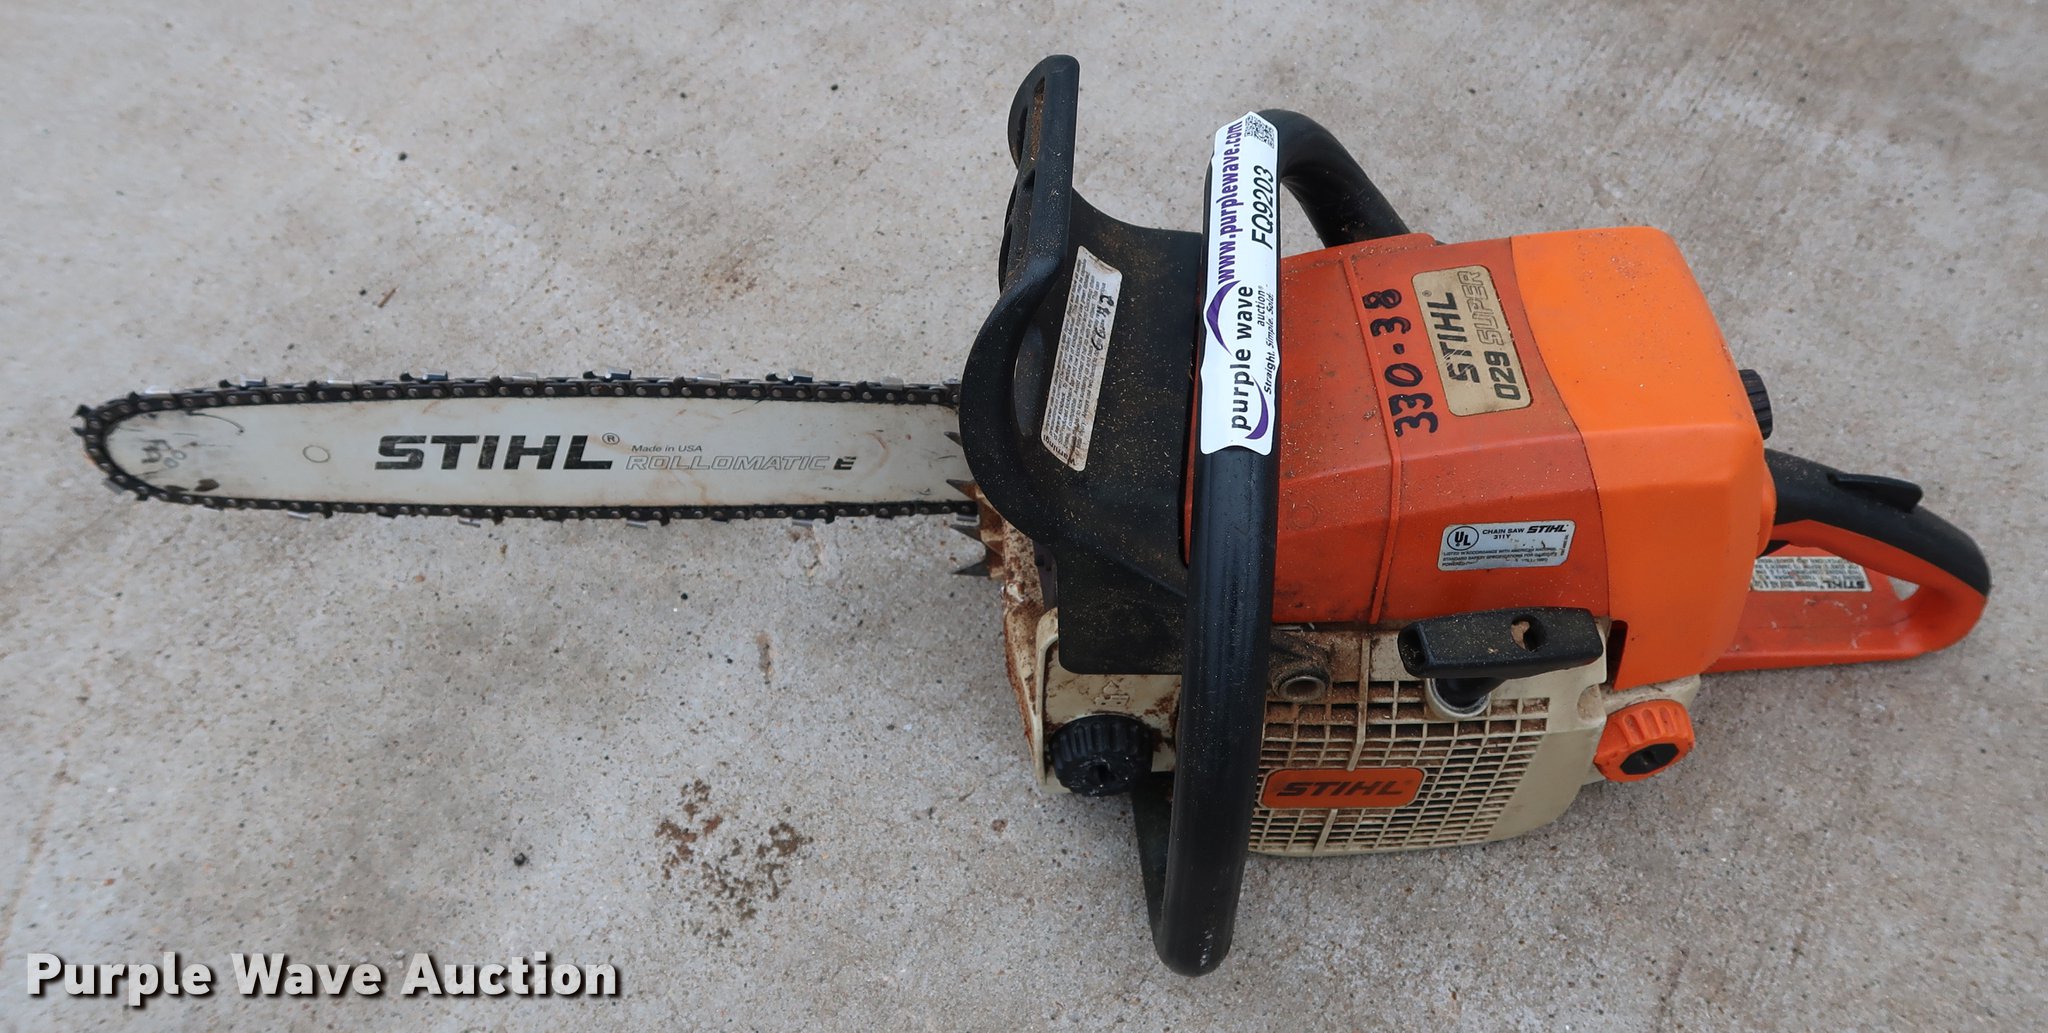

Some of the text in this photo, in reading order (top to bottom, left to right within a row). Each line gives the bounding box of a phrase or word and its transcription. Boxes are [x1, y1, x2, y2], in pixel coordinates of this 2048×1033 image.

[1216, 121, 1244, 285] www.purplewave.com
[1251, 165, 1274, 250] FQ9203
[1255, 290, 1265, 327] auction
[1265, 317, 1276, 350] Simple.
[1427, 292, 1480, 383] STIHL
[1458, 270, 1521, 400] 029 SUPER
[1230, 286, 1254, 431] purple wave
[1264, 351, 1276, 395] Straight.
[1362, 289, 1439, 438] 330-38
[375, 435, 613, 470] STIHL
[626, 455, 857, 471] ROLLOMATIC E
[631, 444, 703, 453] Made in USA
[1454, 531, 1471, 547] UL
[1526, 524, 1567, 534] STIHL
[1276, 780, 1402, 797] STIHL
